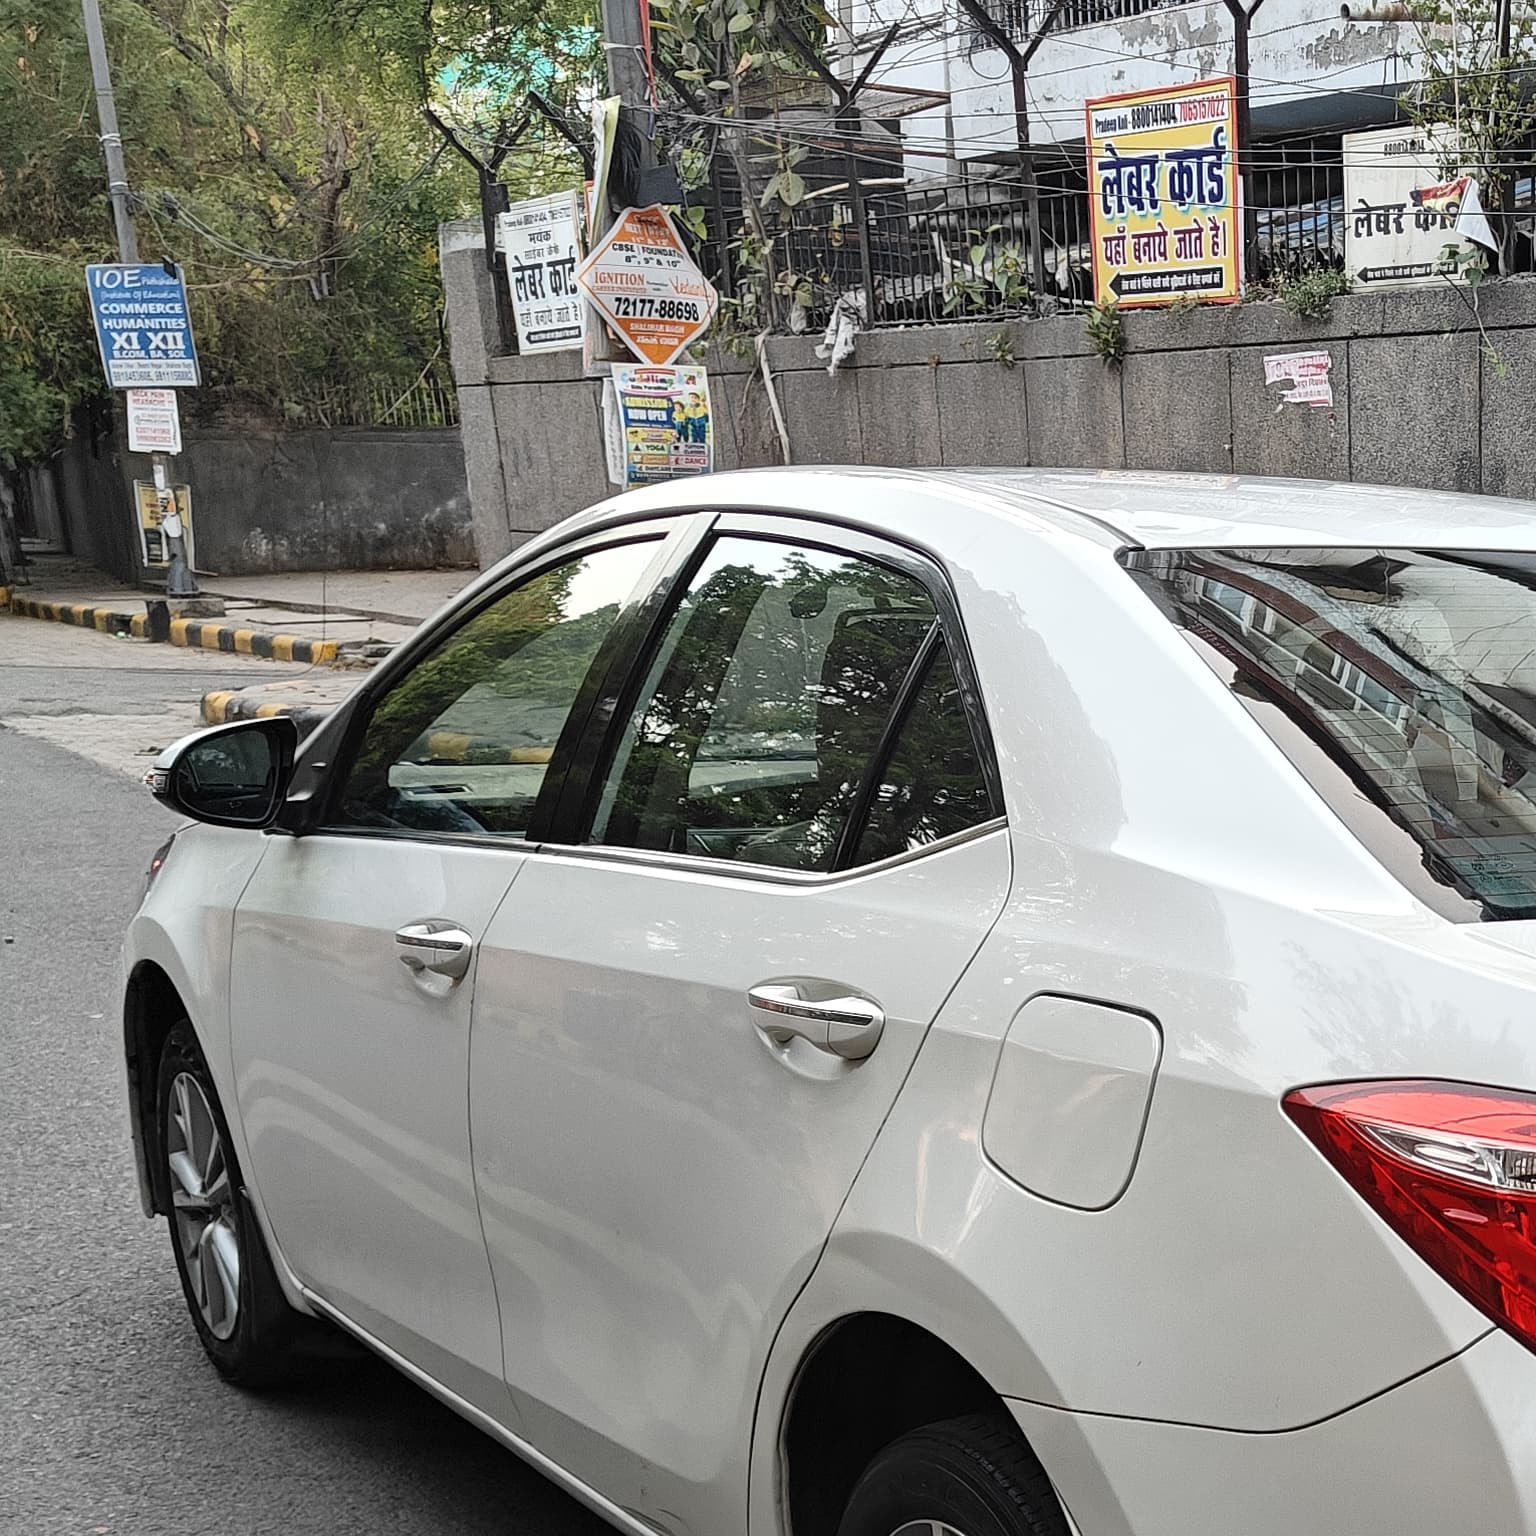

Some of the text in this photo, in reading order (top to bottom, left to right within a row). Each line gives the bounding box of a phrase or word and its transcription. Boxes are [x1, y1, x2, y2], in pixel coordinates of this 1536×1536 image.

[1098, 126, 1226, 216] लेबर कार्ड
[1353, 198, 1407, 239] लेबर
[612, 242, 636, 253] CBSE
[1103, 226, 1127, 265] यहाँ
[1131, 222, 1168, 263] बनाये
[1173, 218, 1204, 260] जाते
[95, 269, 141, 289] IOE
[512, 255, 545, 302] लेबर
[594, 272, 645, 286] IGNITION
[100, 302, 184, 314] COMMERCE
[614, 296, 699, 322] 72177-88698
[102, 317, 187, 330] HUMANITIES
[110, 331, 186, 350] XI XII
